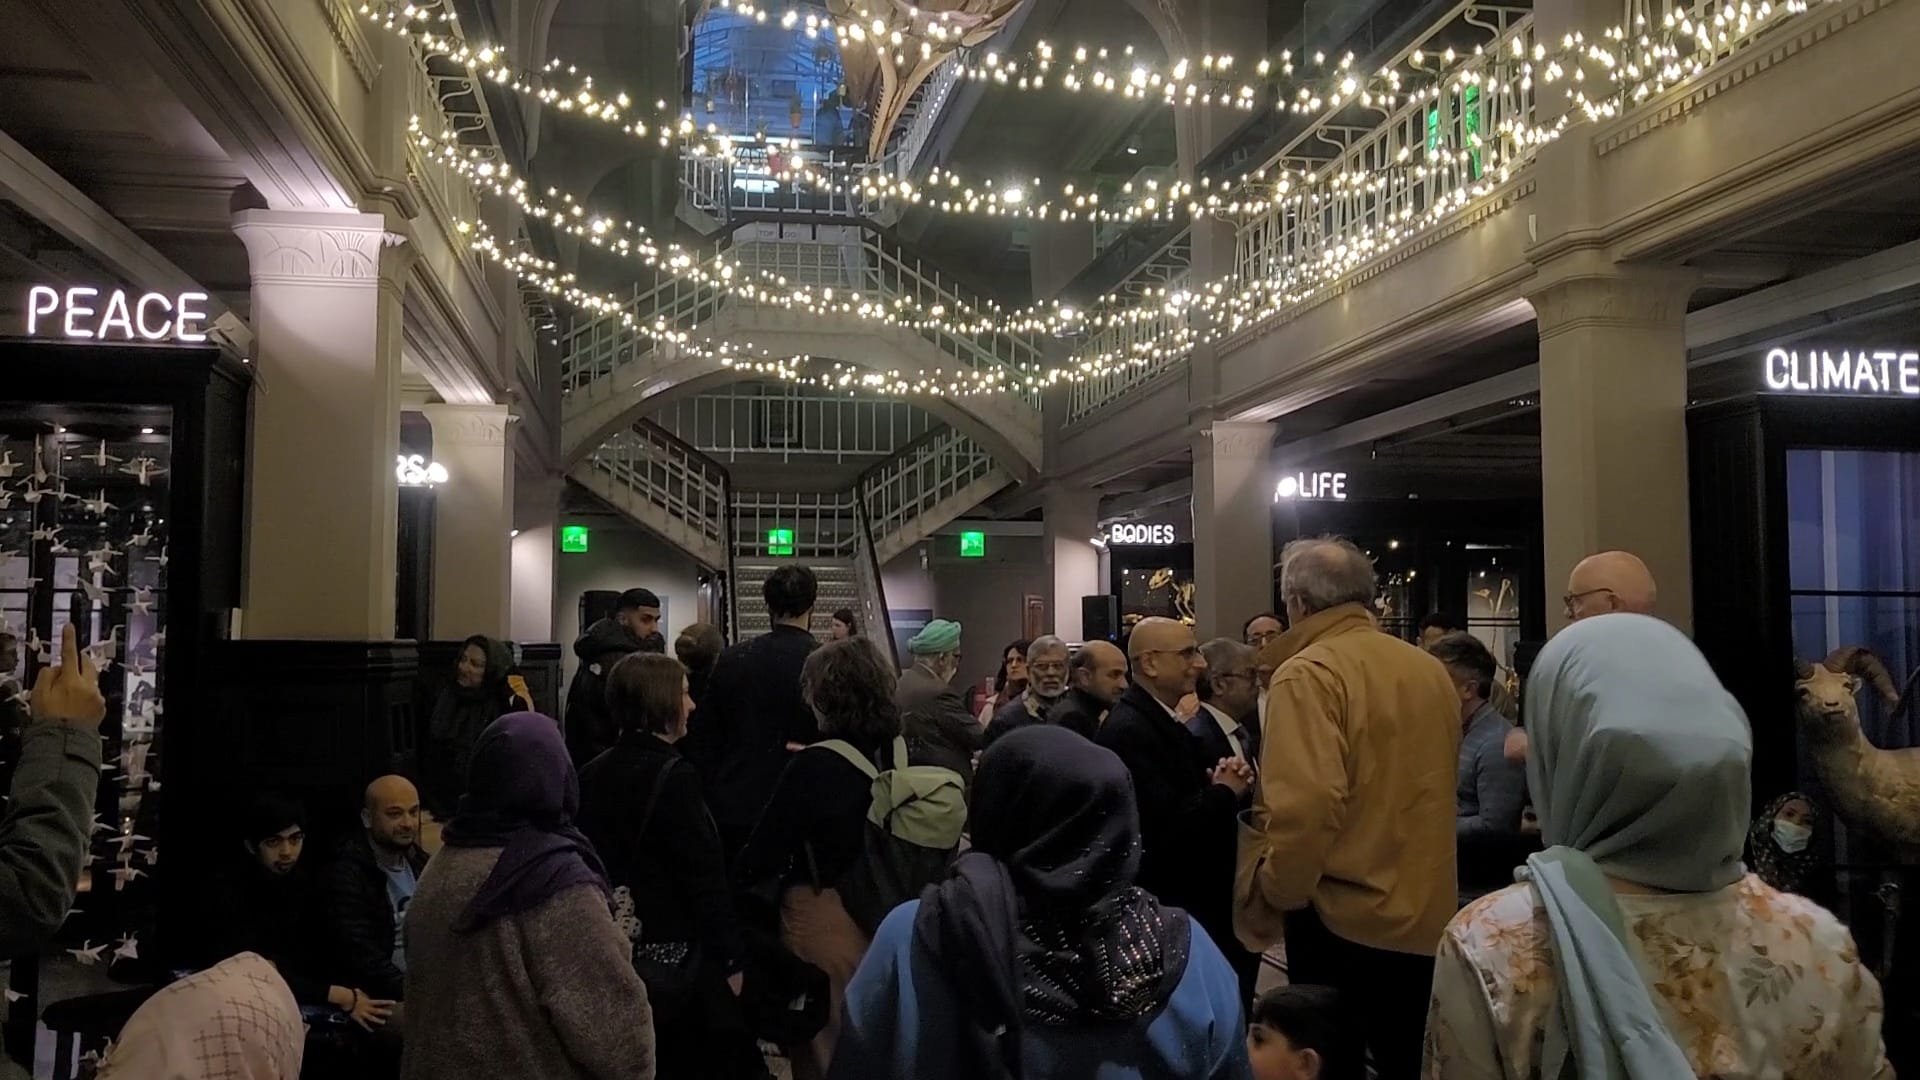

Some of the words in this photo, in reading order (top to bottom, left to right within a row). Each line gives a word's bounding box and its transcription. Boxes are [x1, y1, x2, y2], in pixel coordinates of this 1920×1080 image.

[27, 286, 208, 342] PEACE
[1765, 349, 1920, 394] CLIMATE
[1299, 472, 1347, 499] LIFE
[1112, 523, 1175, 544] BODIES
